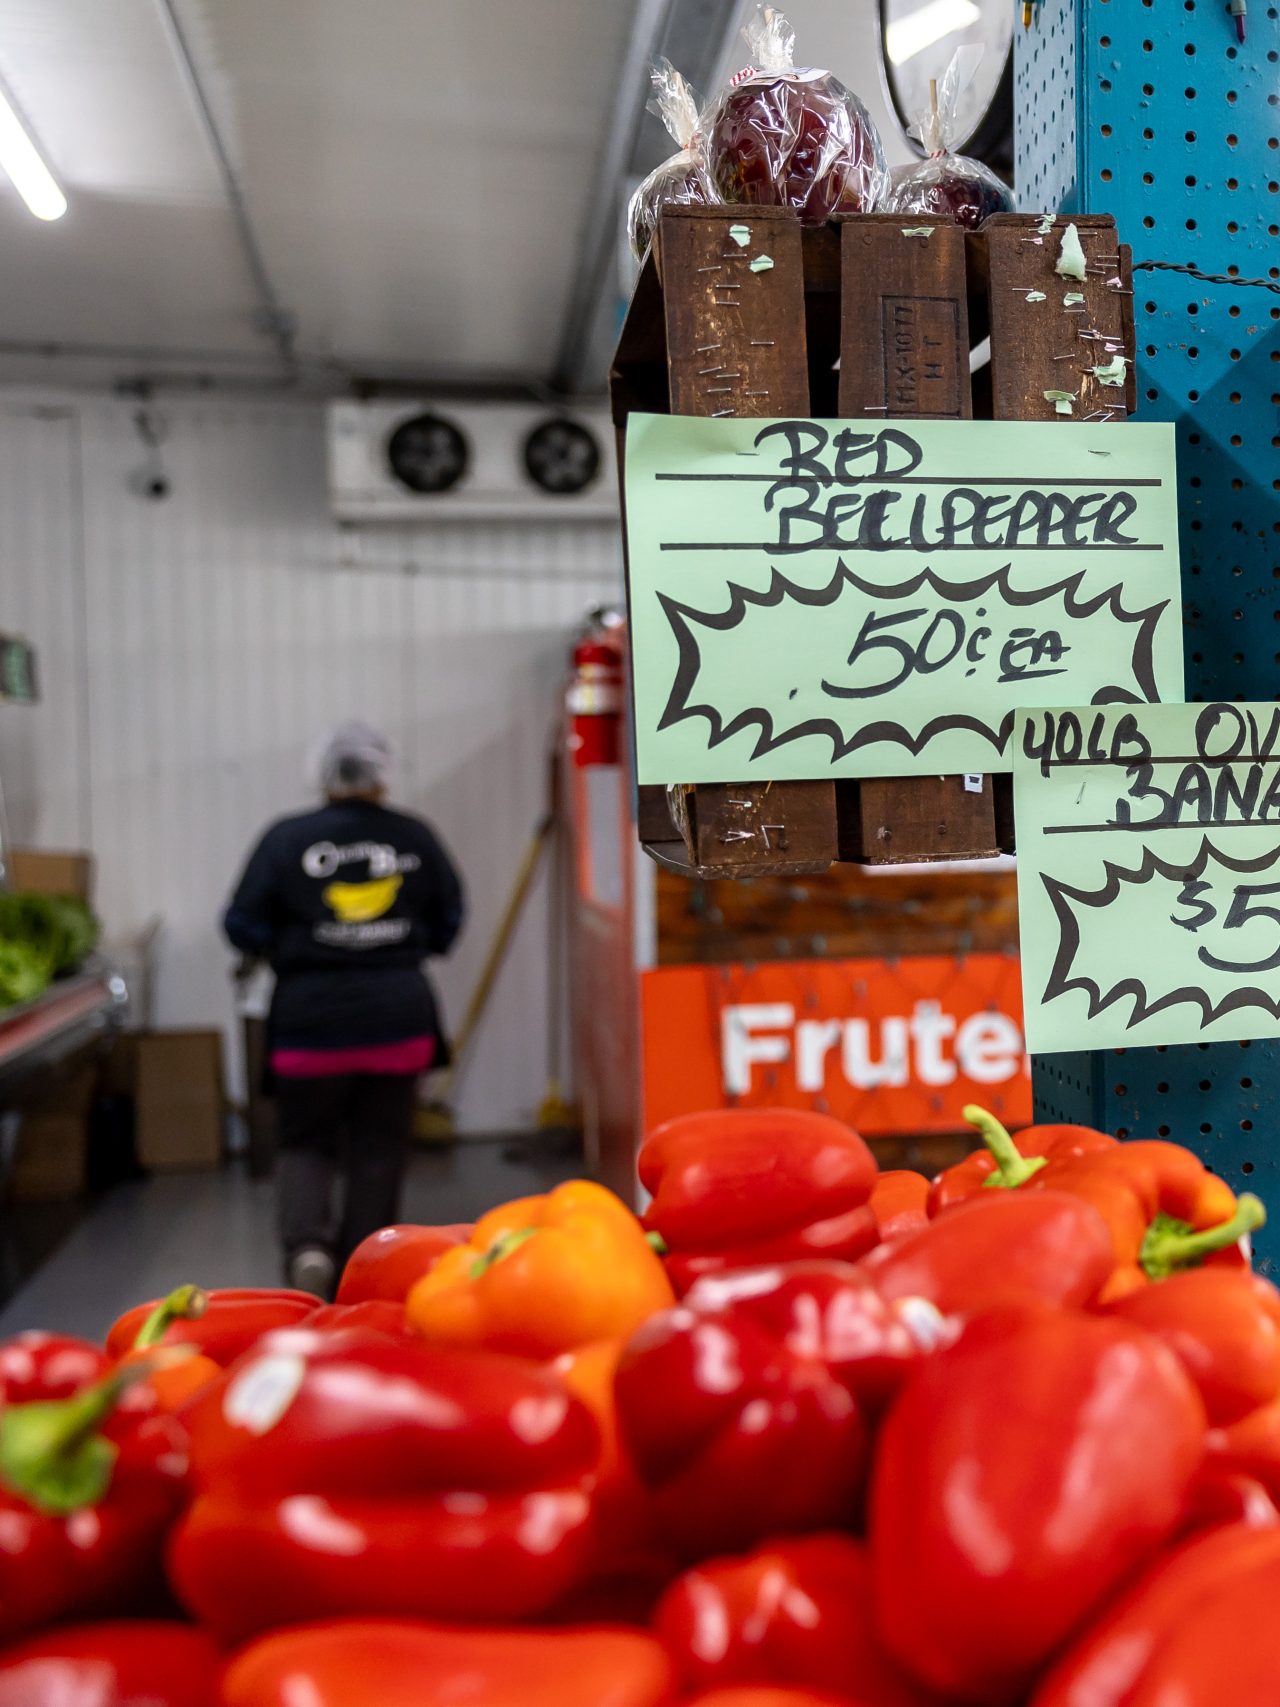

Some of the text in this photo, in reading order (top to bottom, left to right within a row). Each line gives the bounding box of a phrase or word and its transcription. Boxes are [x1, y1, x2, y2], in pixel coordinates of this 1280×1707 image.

[754, 421, 923, 487] RED
[998, 628, 1072, 682] EA
[1022, 710, 1154, 777] 40LB
